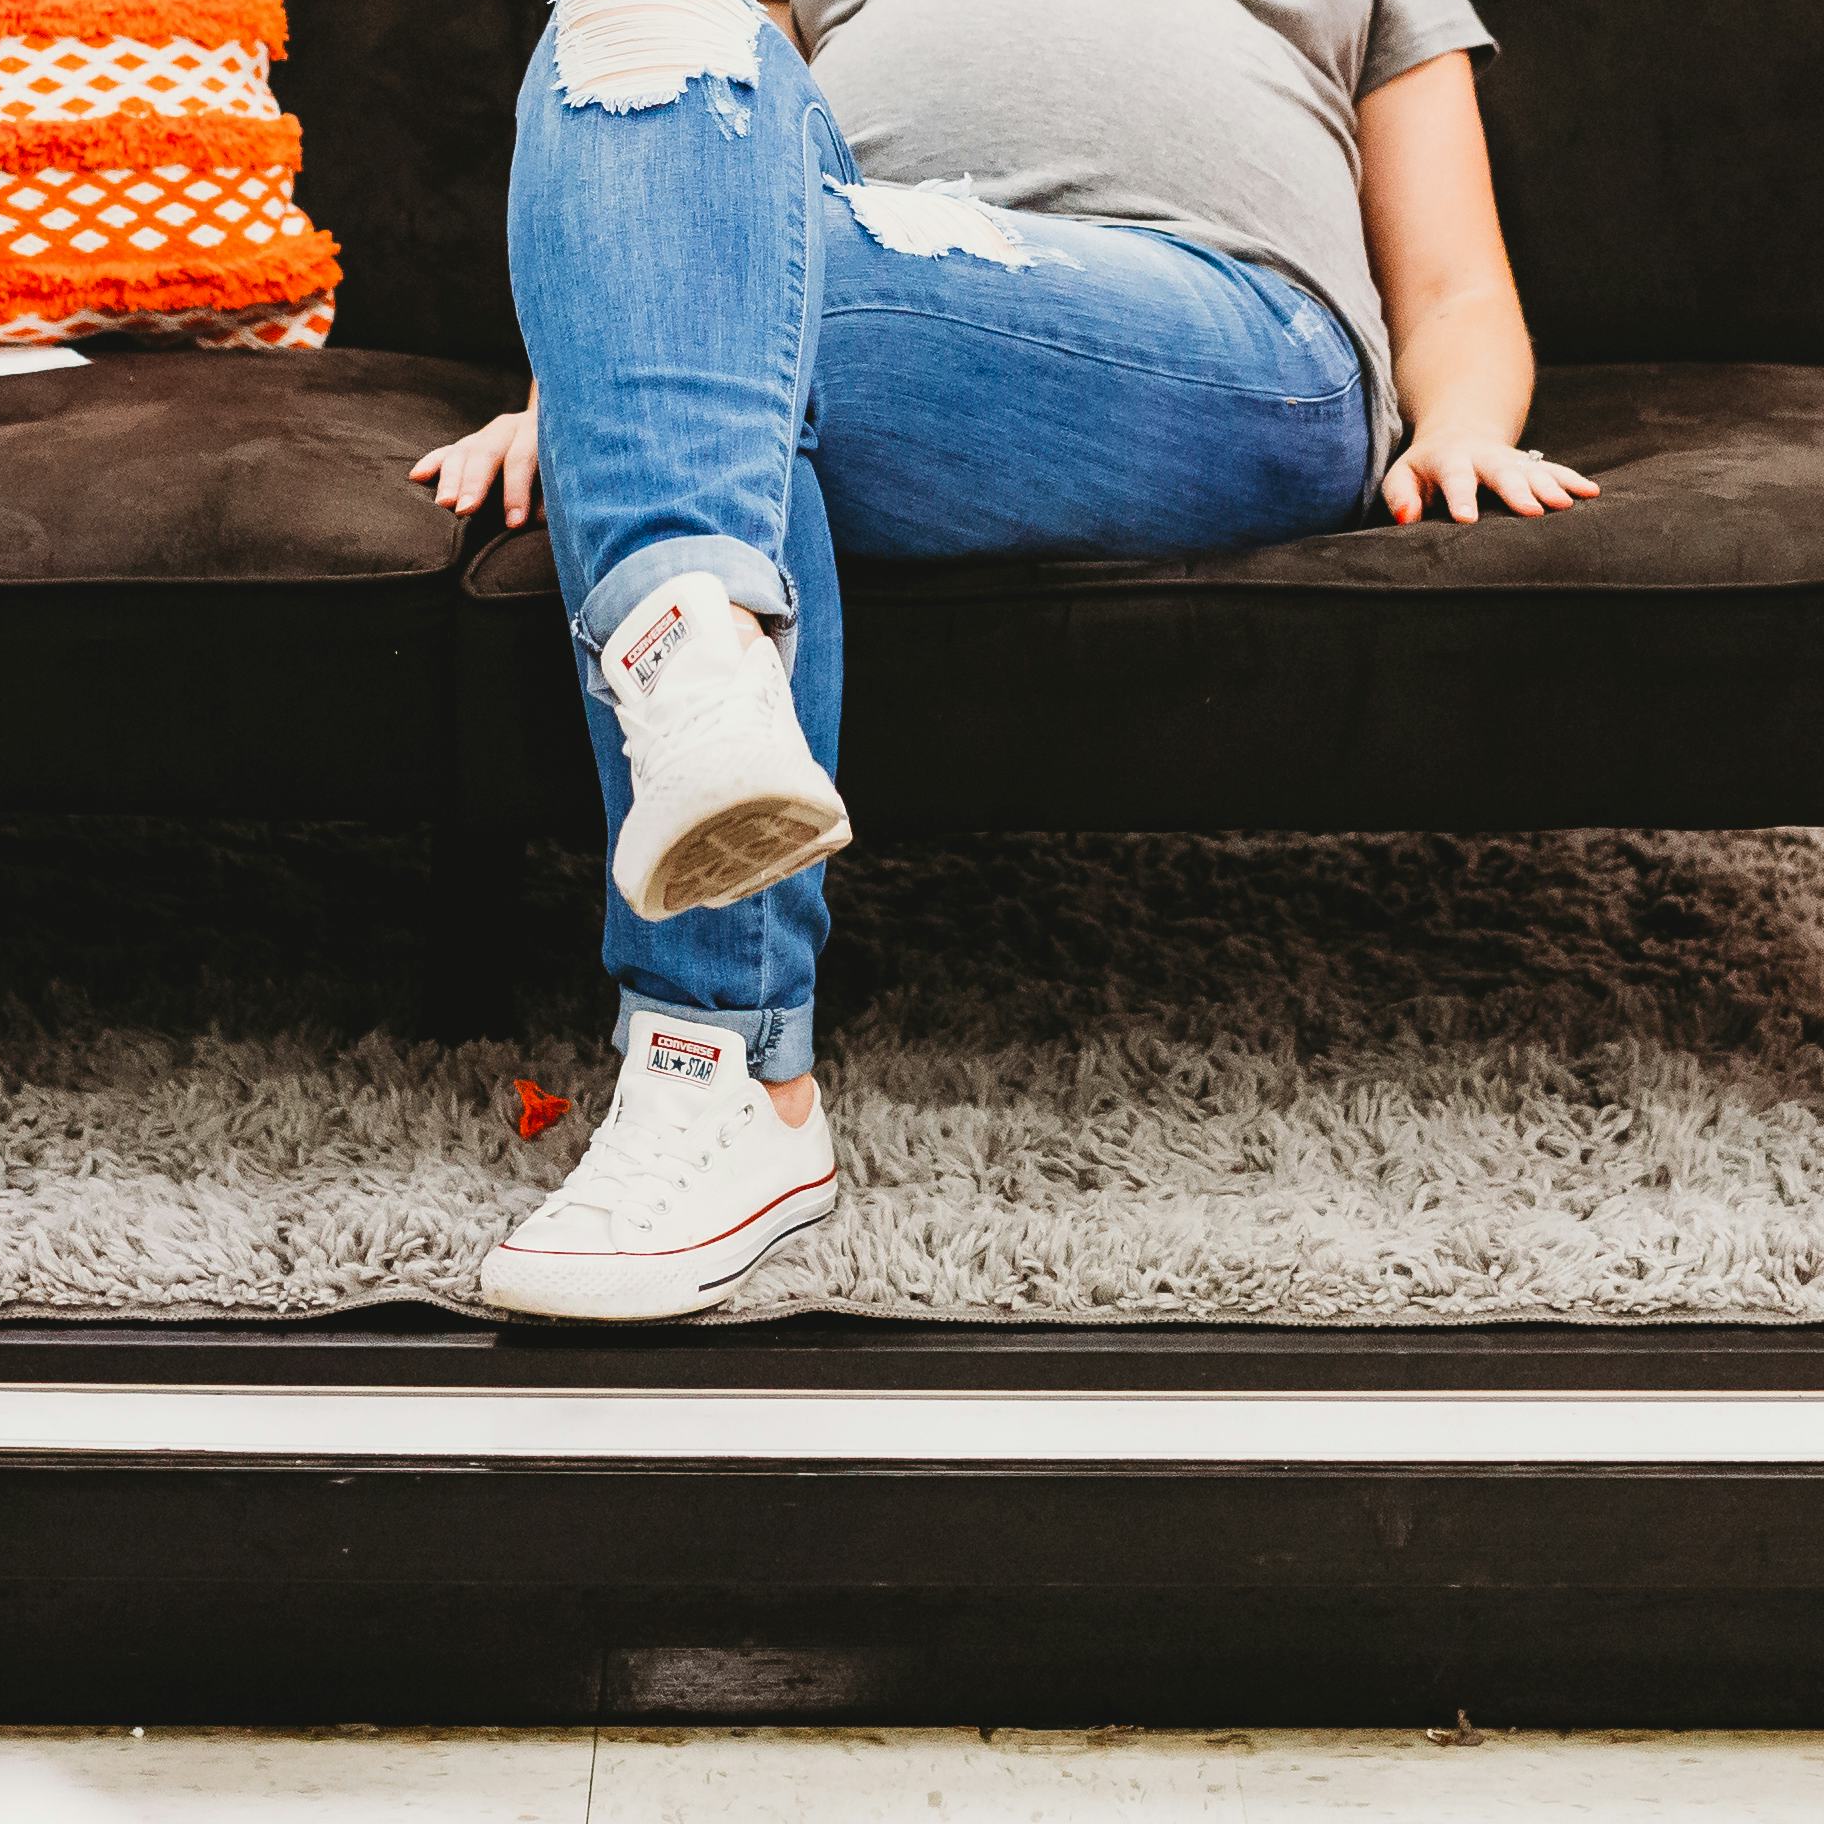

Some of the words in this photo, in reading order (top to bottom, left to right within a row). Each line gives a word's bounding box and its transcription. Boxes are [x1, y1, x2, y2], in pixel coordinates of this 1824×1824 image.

[634, 657, 655, 686] ALL
[661, 621, 687, 653] STAR
[657, 1036, 715, 1058] CONVERSE
[651, 1049, 670, 1071] ALL
[685, 1057, 714, 1081] STAR
